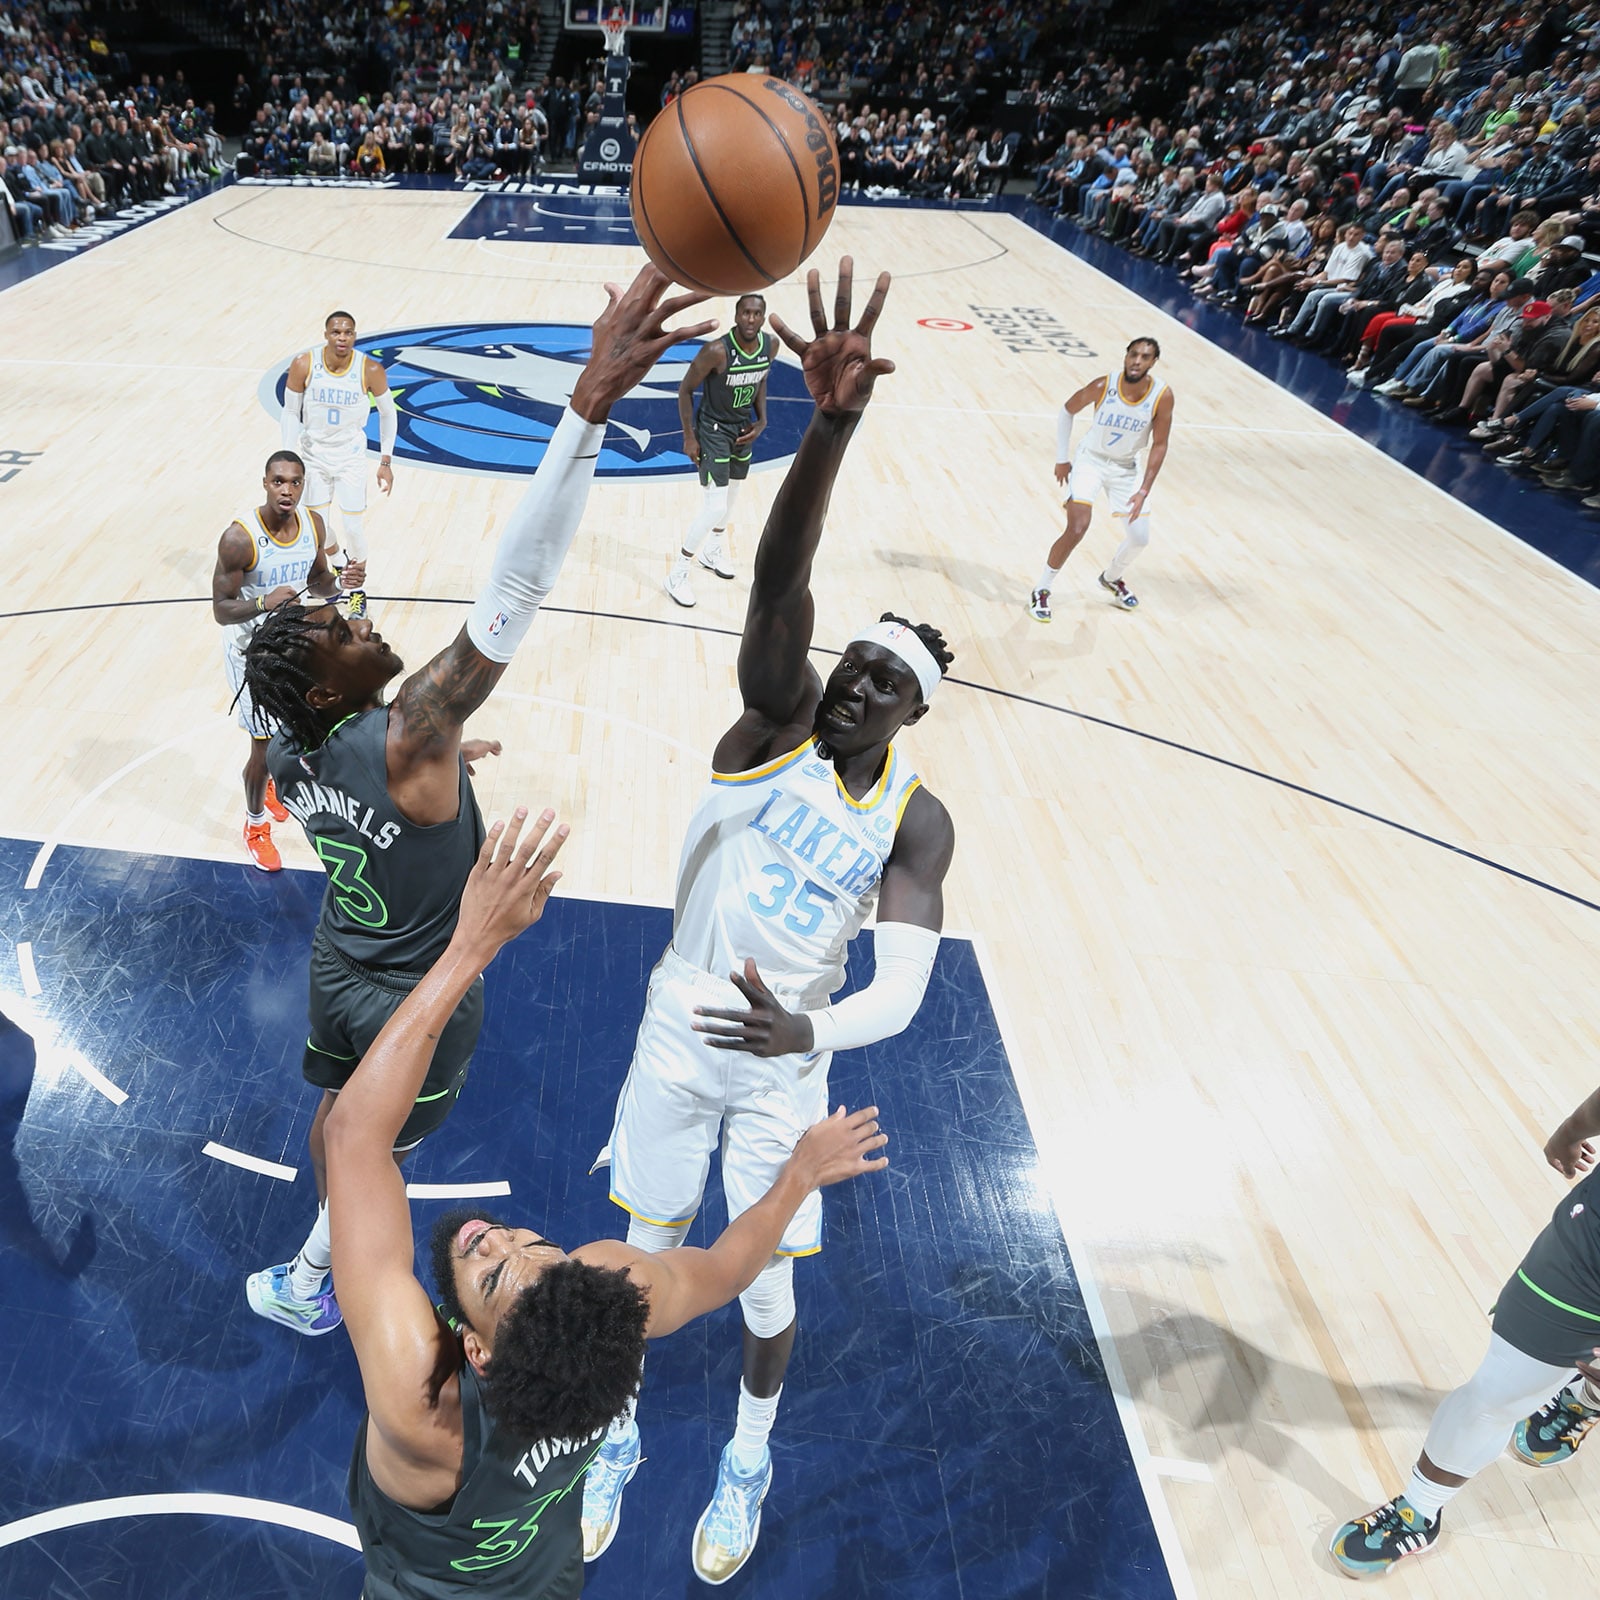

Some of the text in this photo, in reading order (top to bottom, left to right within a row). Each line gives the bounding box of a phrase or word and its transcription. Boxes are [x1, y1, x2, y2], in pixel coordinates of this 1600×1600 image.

[462, 181, 632, 196] MINNE
[968, 303, 1048, 354] TARGET
[1011, 306, 1099, 358] CENTER
[312, 387, 359, 405] LAKERS
[733, 385, 755, 408] 12
[327, 408, 340, 425] 0
[1097, 412, 1147, 432] LAKERS
[1107, 432, 1123, 446] 7
[316, 836, 388, 927] 3
[747, 863, 838, 937] 35
